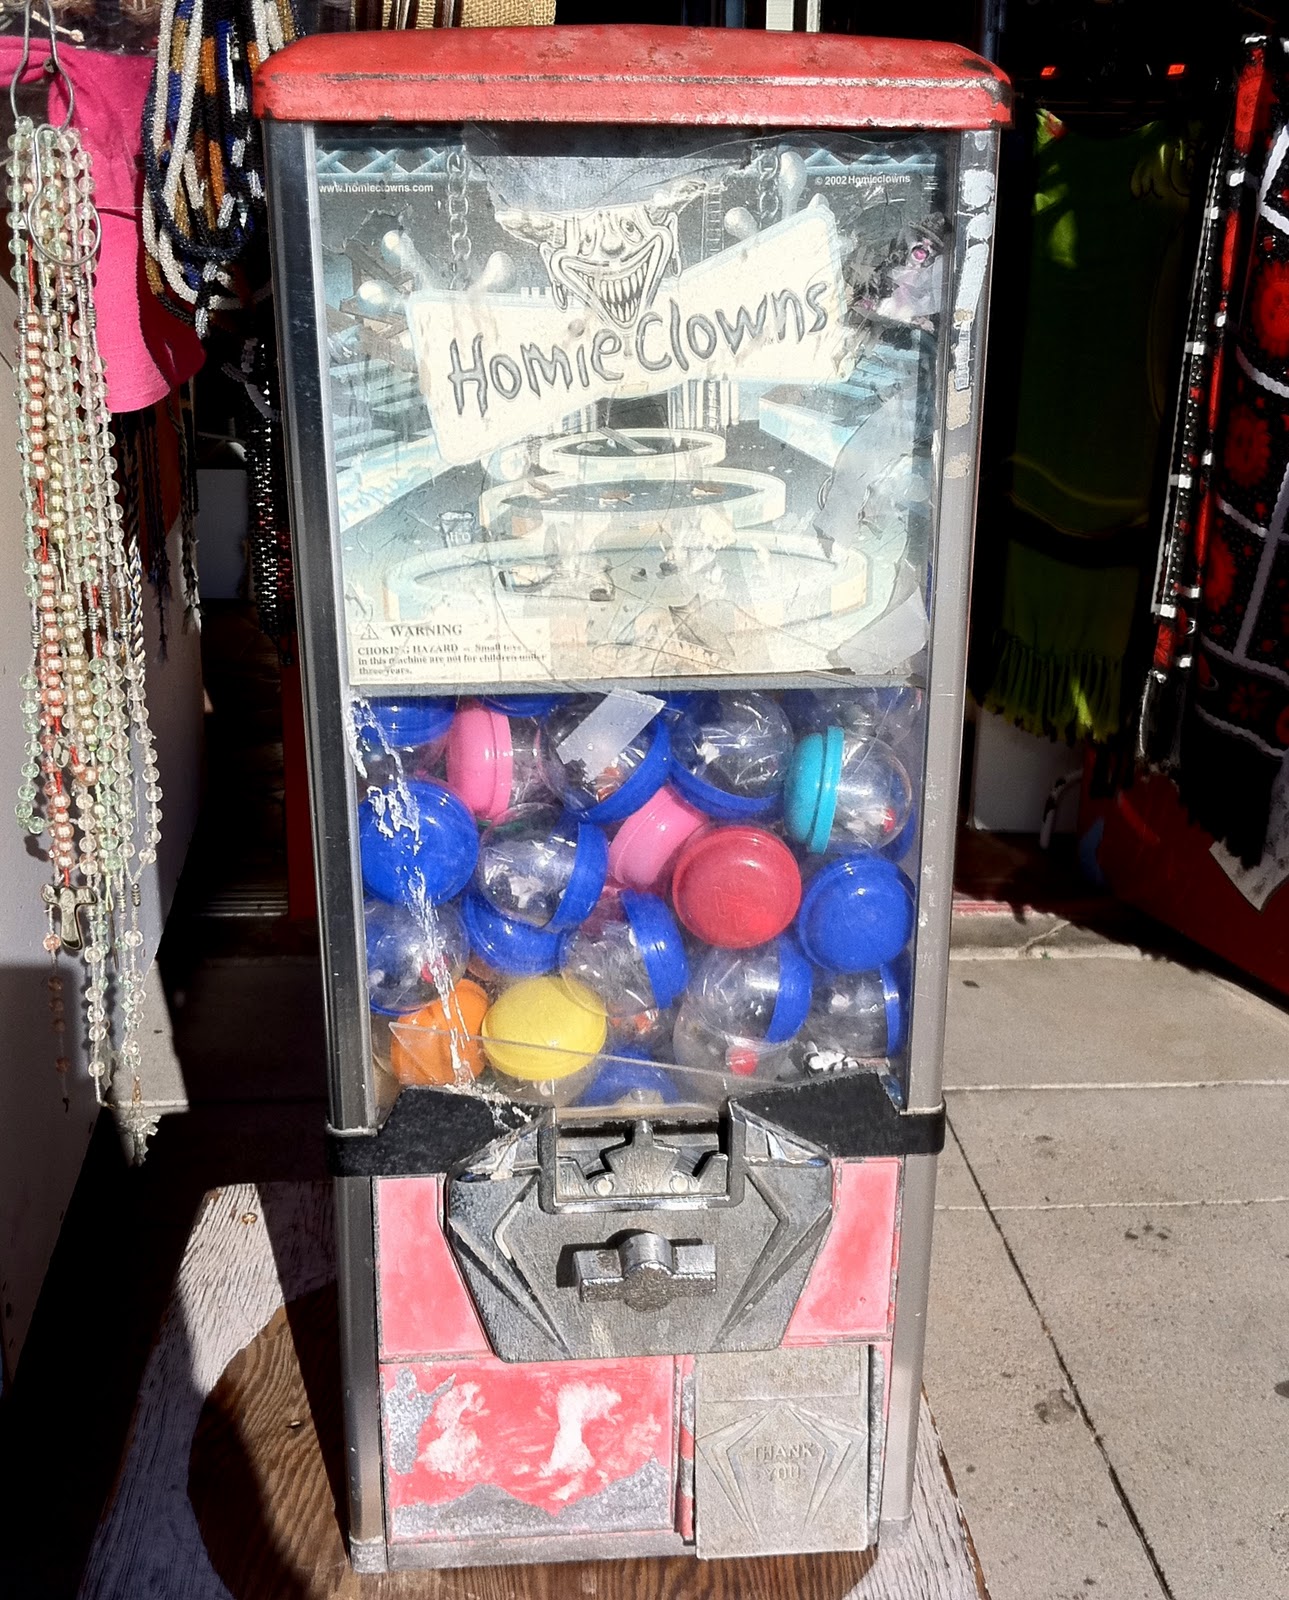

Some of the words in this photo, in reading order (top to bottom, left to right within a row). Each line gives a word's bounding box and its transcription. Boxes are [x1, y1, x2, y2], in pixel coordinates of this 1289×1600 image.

[824, 176, 847, 186] 2002
[447, 327, 625, 418] Homie
[634, 281, 829, 373] Clowns
[390, 624, 462, 637] WARNING
[370, 657, 387, 665] this
[753, 1442, 816, 1460] THANK
[764, 1462, 801, 1482] YOU
